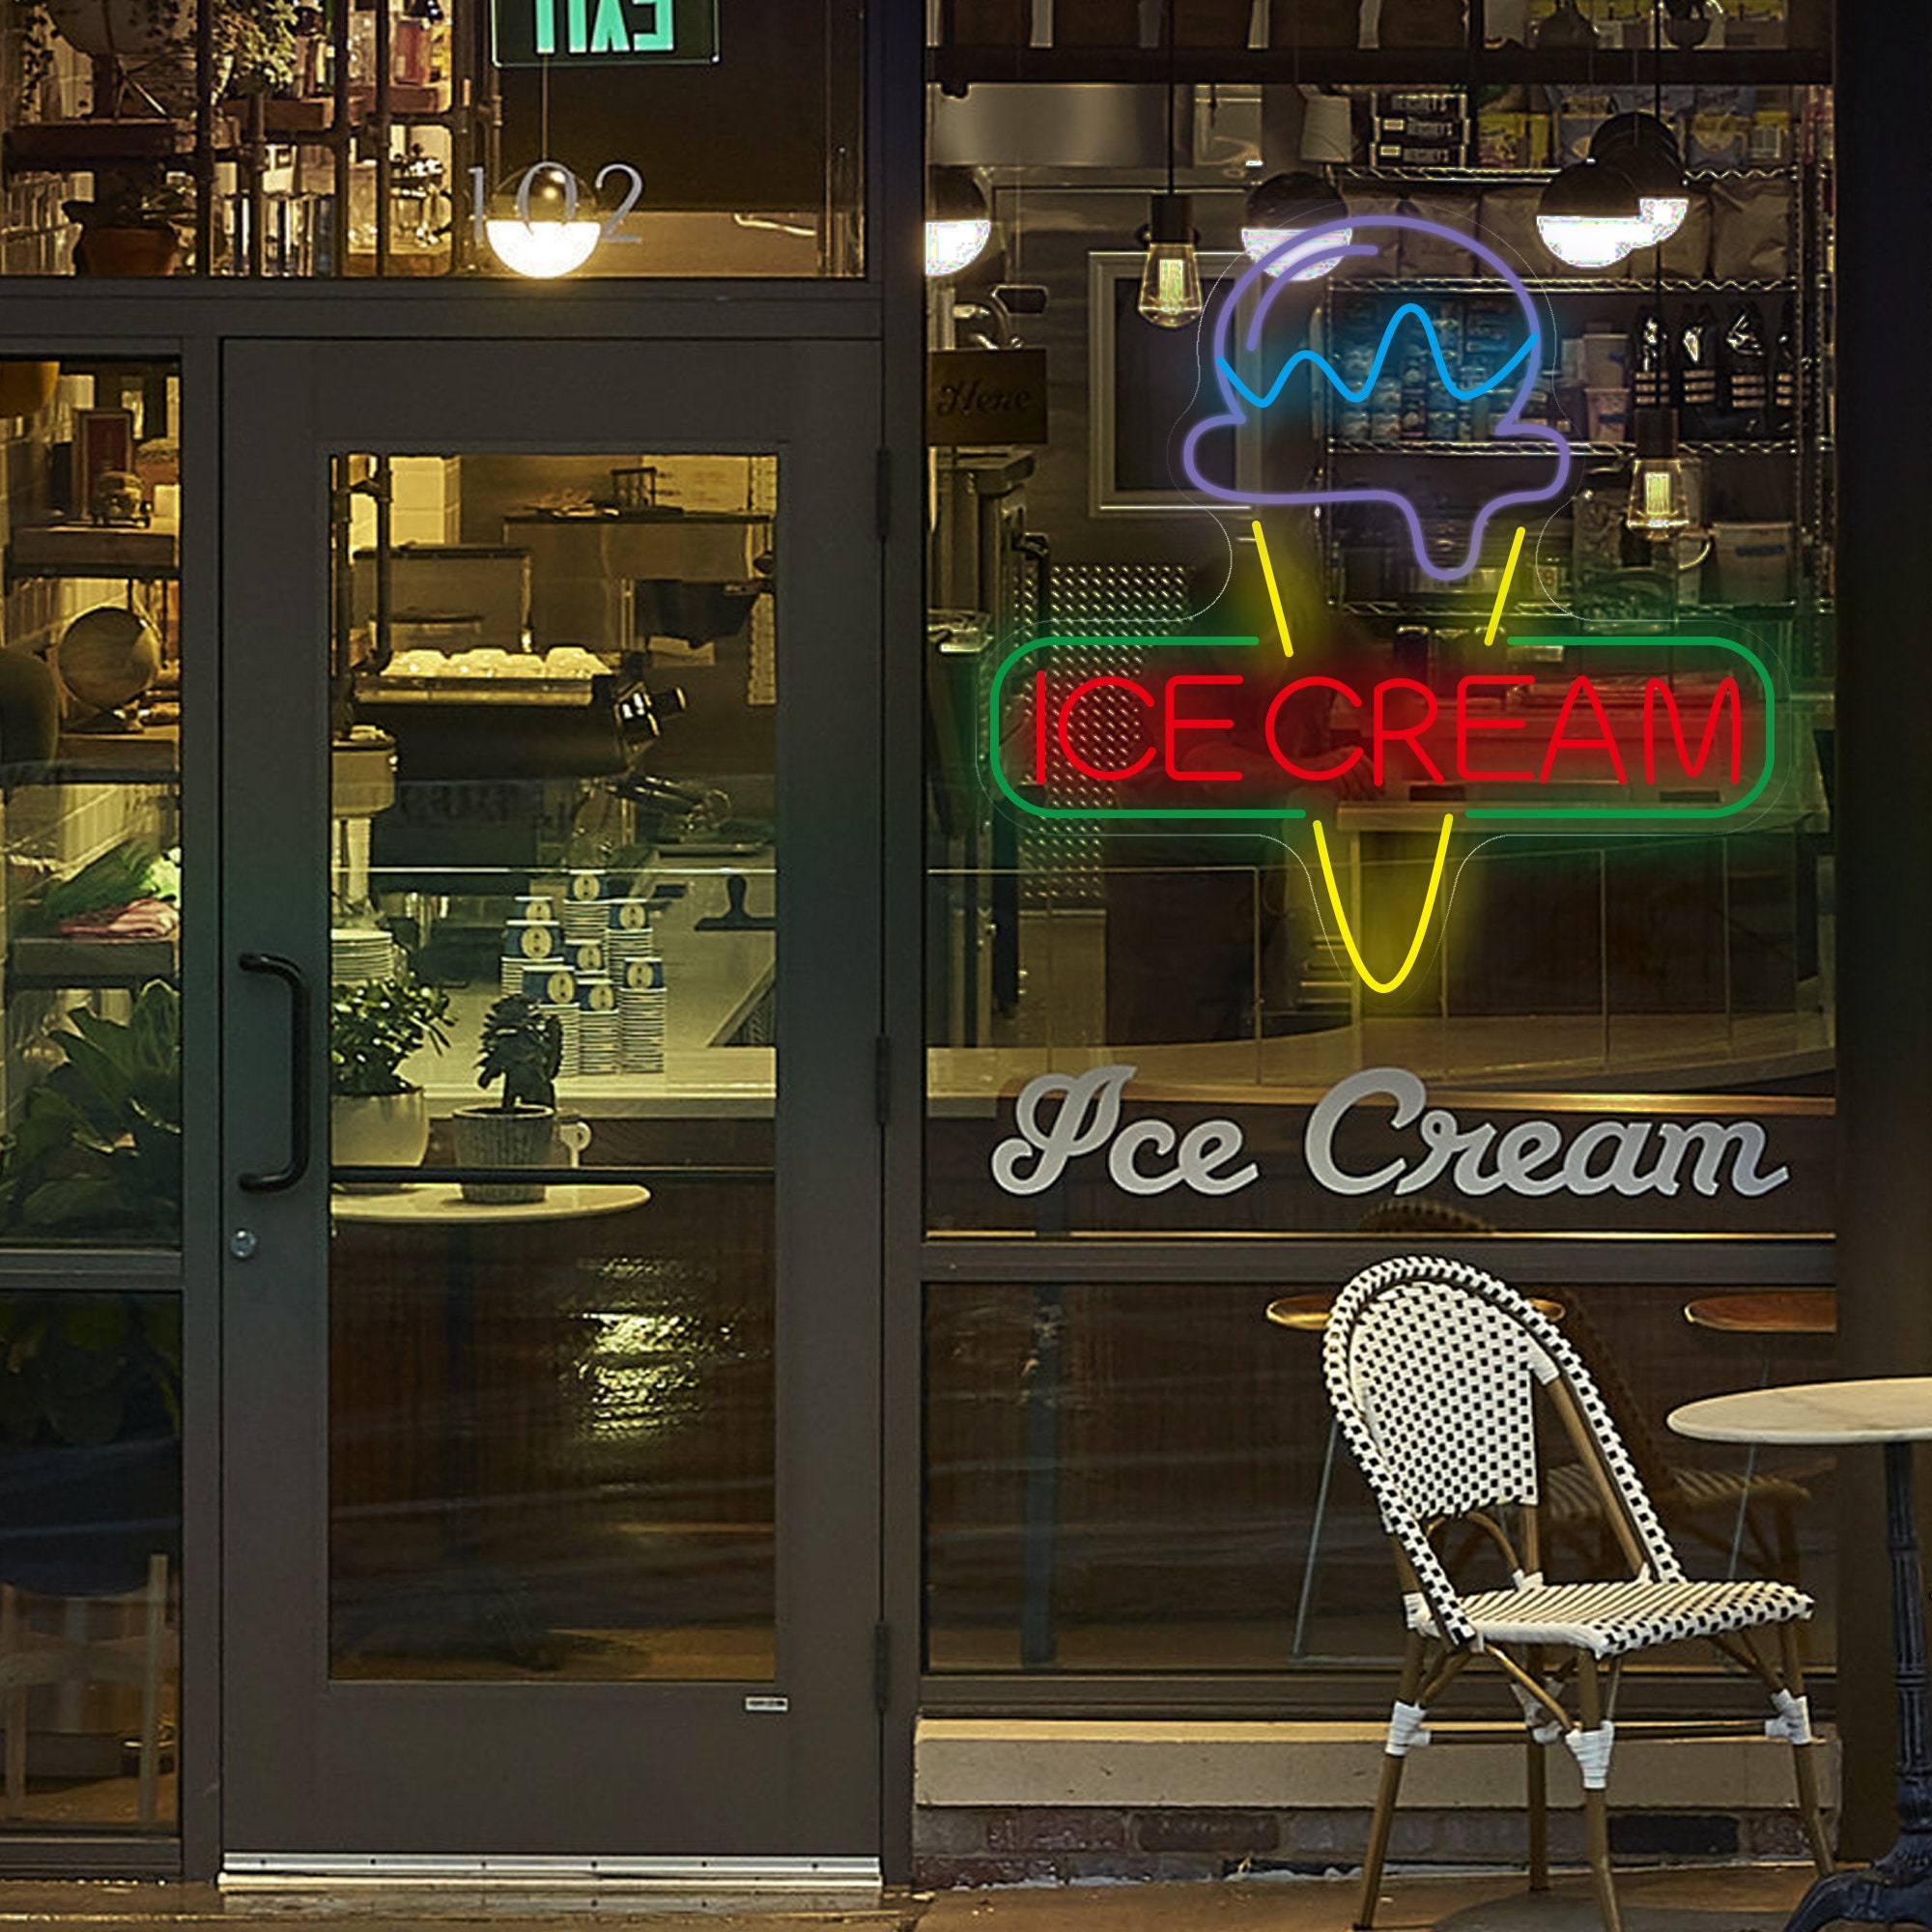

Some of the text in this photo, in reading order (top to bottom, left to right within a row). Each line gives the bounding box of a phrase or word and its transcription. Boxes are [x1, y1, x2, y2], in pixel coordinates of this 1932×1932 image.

[469, 161, 643, 244] 102
[1036, 671, 1741, 785] ICE CREAM
[990, 1065, 1789, 1196] Ice Cream
